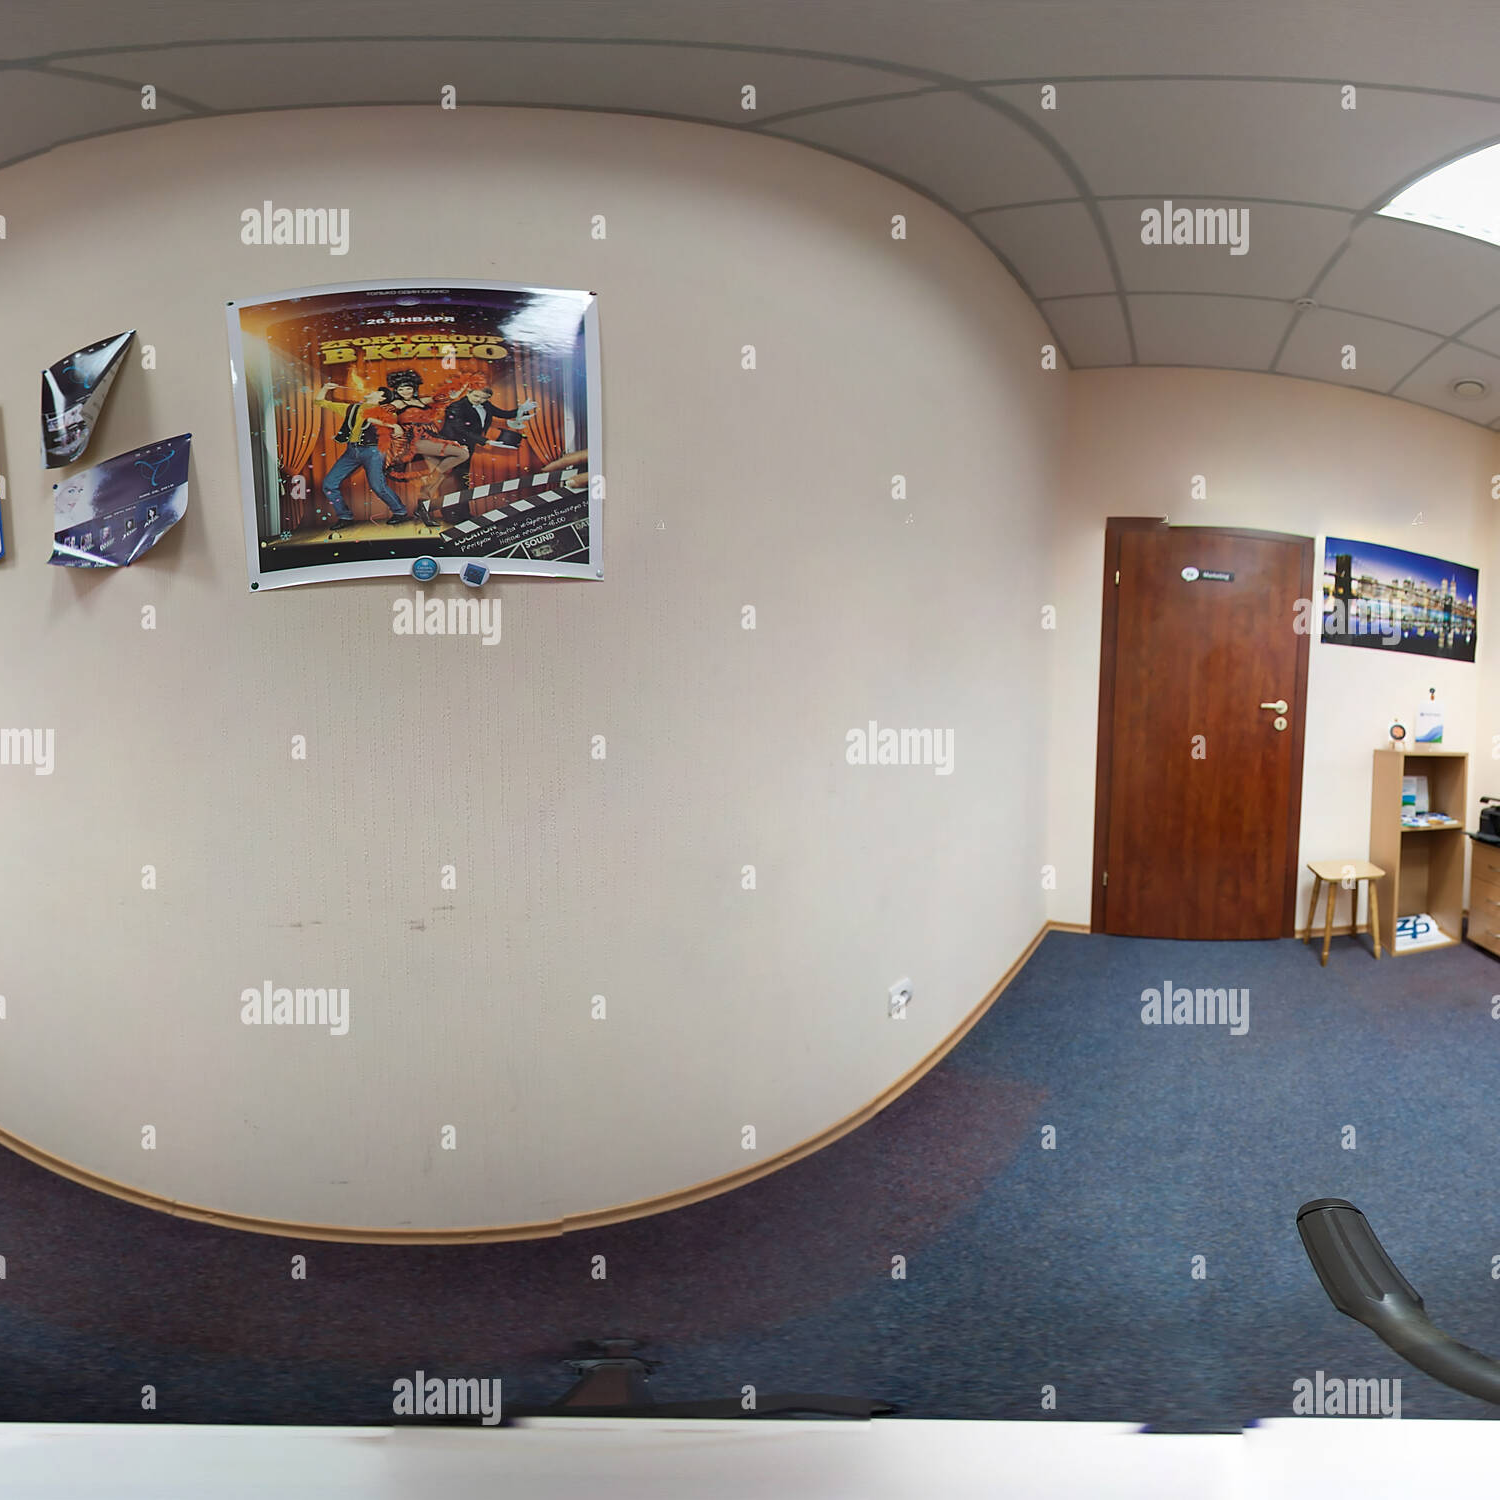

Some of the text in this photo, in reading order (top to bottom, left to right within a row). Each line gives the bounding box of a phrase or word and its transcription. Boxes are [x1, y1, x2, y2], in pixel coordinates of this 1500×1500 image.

[366, 315, 456, 326] 26 ЯНВАРЯ
[320, 334, 504, 350] ZFORT GROUP
[322, 343, 509, 365] В КИНО
[524, 532, 556, 549] SOUND
